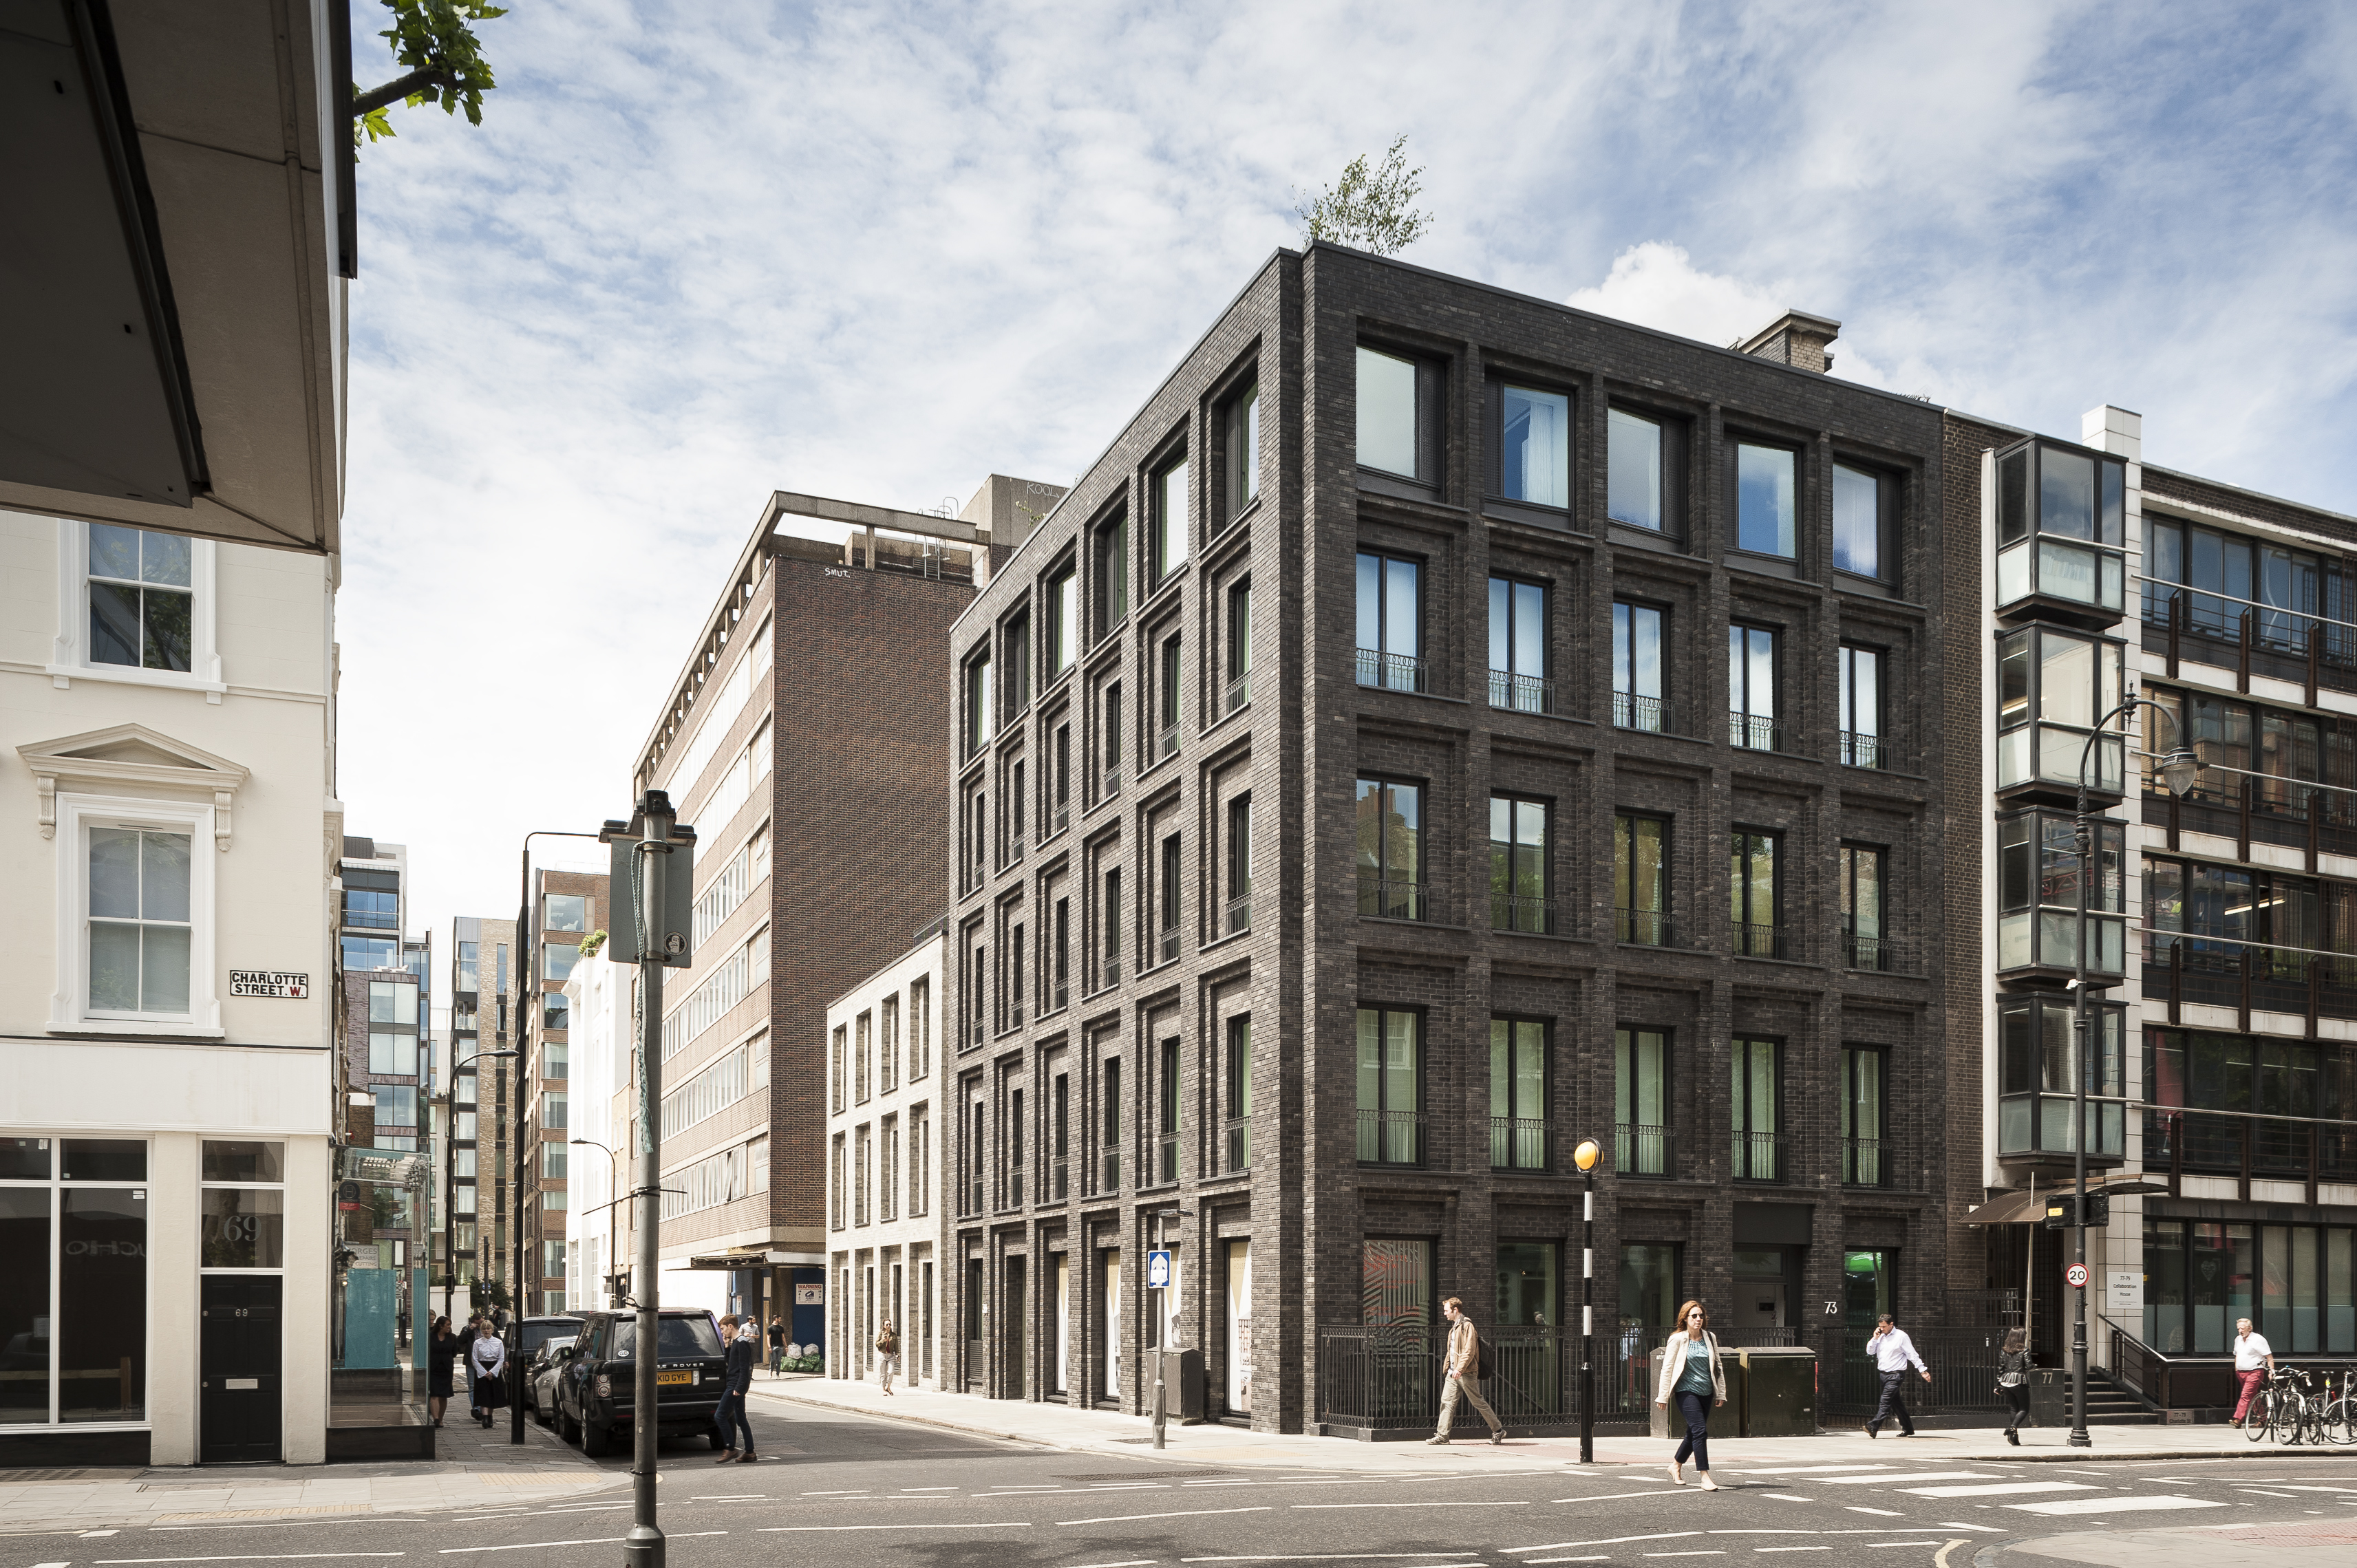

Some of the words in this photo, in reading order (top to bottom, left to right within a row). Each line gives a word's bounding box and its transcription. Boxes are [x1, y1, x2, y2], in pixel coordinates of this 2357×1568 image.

[231, 972, 306, 986] CHARLOTTE
[223, 1215, 262, 1242] 69
[2069, 1271, 2085, 1280] 20
[235, 1309, 248, 1317] 69
[1824, 1301, 1837, 1314] 73
[657, 1374, 670, 1382] K10
[671, 1373, 687, 1382] GYE
[2042, 1372, 2053, 1384] 77
